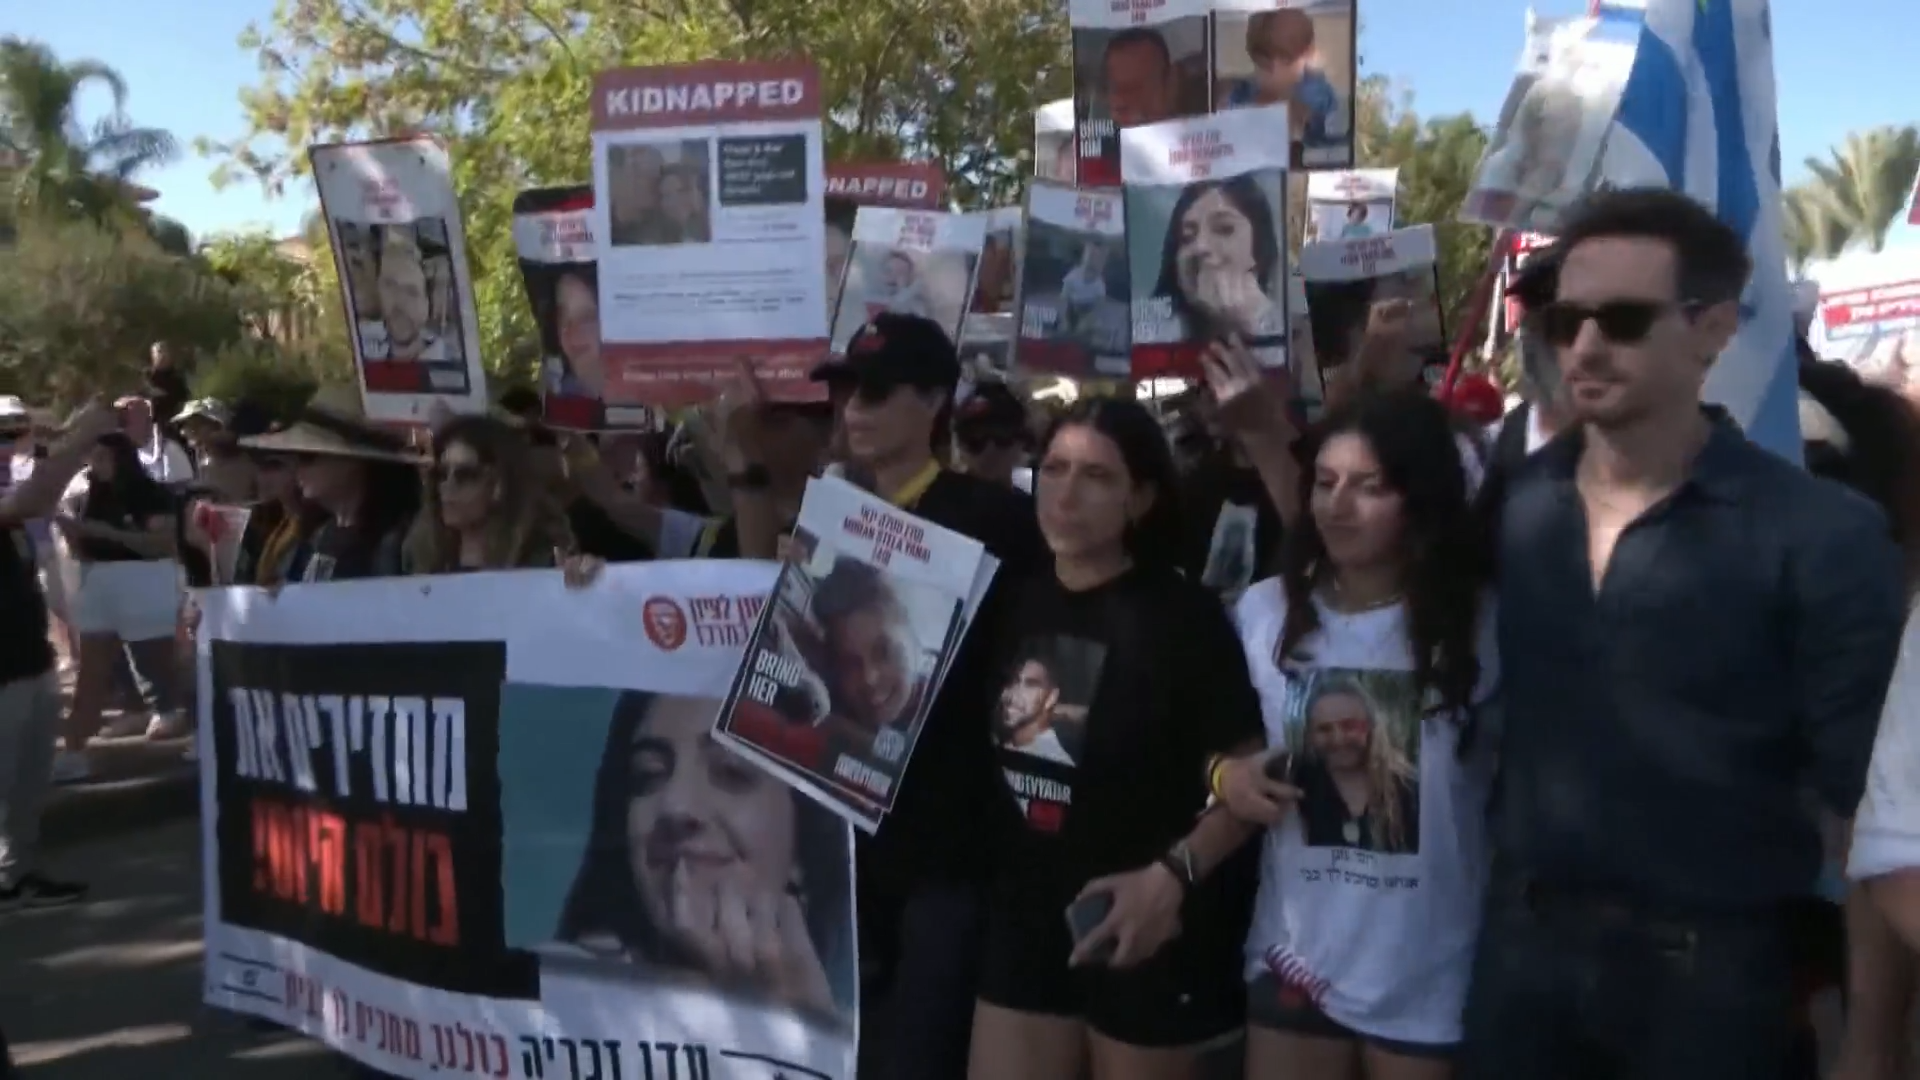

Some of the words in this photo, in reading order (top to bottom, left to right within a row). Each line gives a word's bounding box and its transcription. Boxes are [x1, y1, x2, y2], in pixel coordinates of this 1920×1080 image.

[605, 78, 805, 117] KIDNAPPED
[825, 175, 929, 199] NAPPED
[755, 648, 802, 689] BRING
[748, 672, 778, 708] HER
[227, 686, 287, 783] את
[279, 692, 469, 812] מחזירים
[355, 810, 460, 948] כולם
